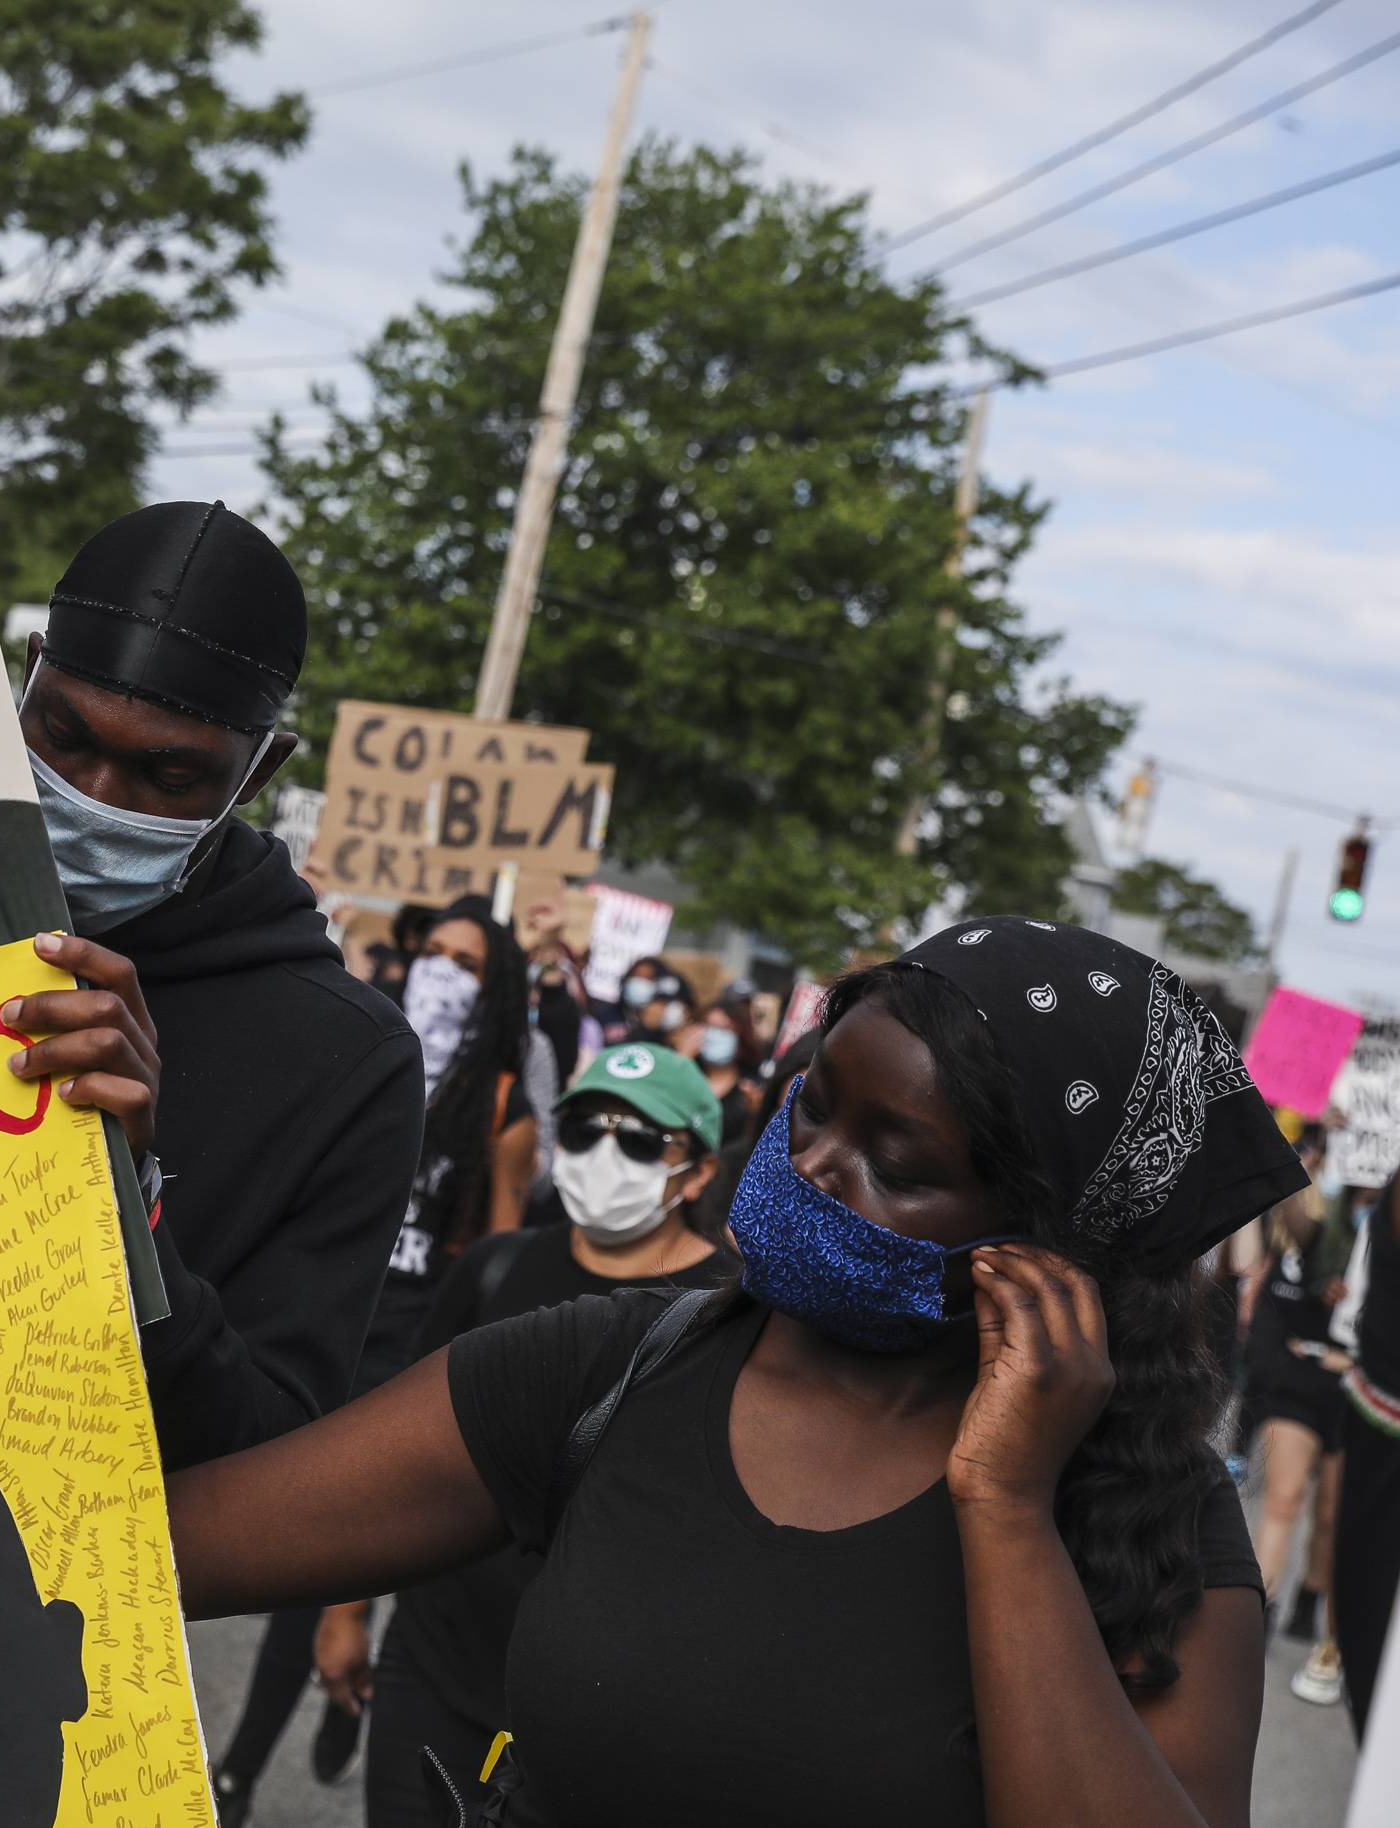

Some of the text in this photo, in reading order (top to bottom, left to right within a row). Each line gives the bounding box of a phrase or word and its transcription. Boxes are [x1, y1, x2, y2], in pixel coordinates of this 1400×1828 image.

[438, 774, 599, 850] BLM
[3, 1151, 58, 1197] Taylor
[81, 1129, 106, 1189] Anthony
[45, 1236, 84, 1273] Gray
[95, 1200, 120, 1252] Keller
[7, 1269, 88, 1327] Akai Gurley
[114, 1331, 145, 1412] Hamilton
[7, 1397, 121, 1435] Brandon Webber
[59, 1440, 125, 1478] Arbery
[29, 1467, 76, 1571] Oscar Grant
[79, 1478, 163, 1516] Botham Jean
[44, 1548, 73, 1600] Wendell
[118, 1516, 147, 1609] Hockaday
[145, 1536, 183, 1687] Darrius Stewart
[75, 1705, 172, 1779] Kendra James
[177, 1718, 202, 1774] McCoy
[81, 1760, 181, 1824] Jamar Clark
